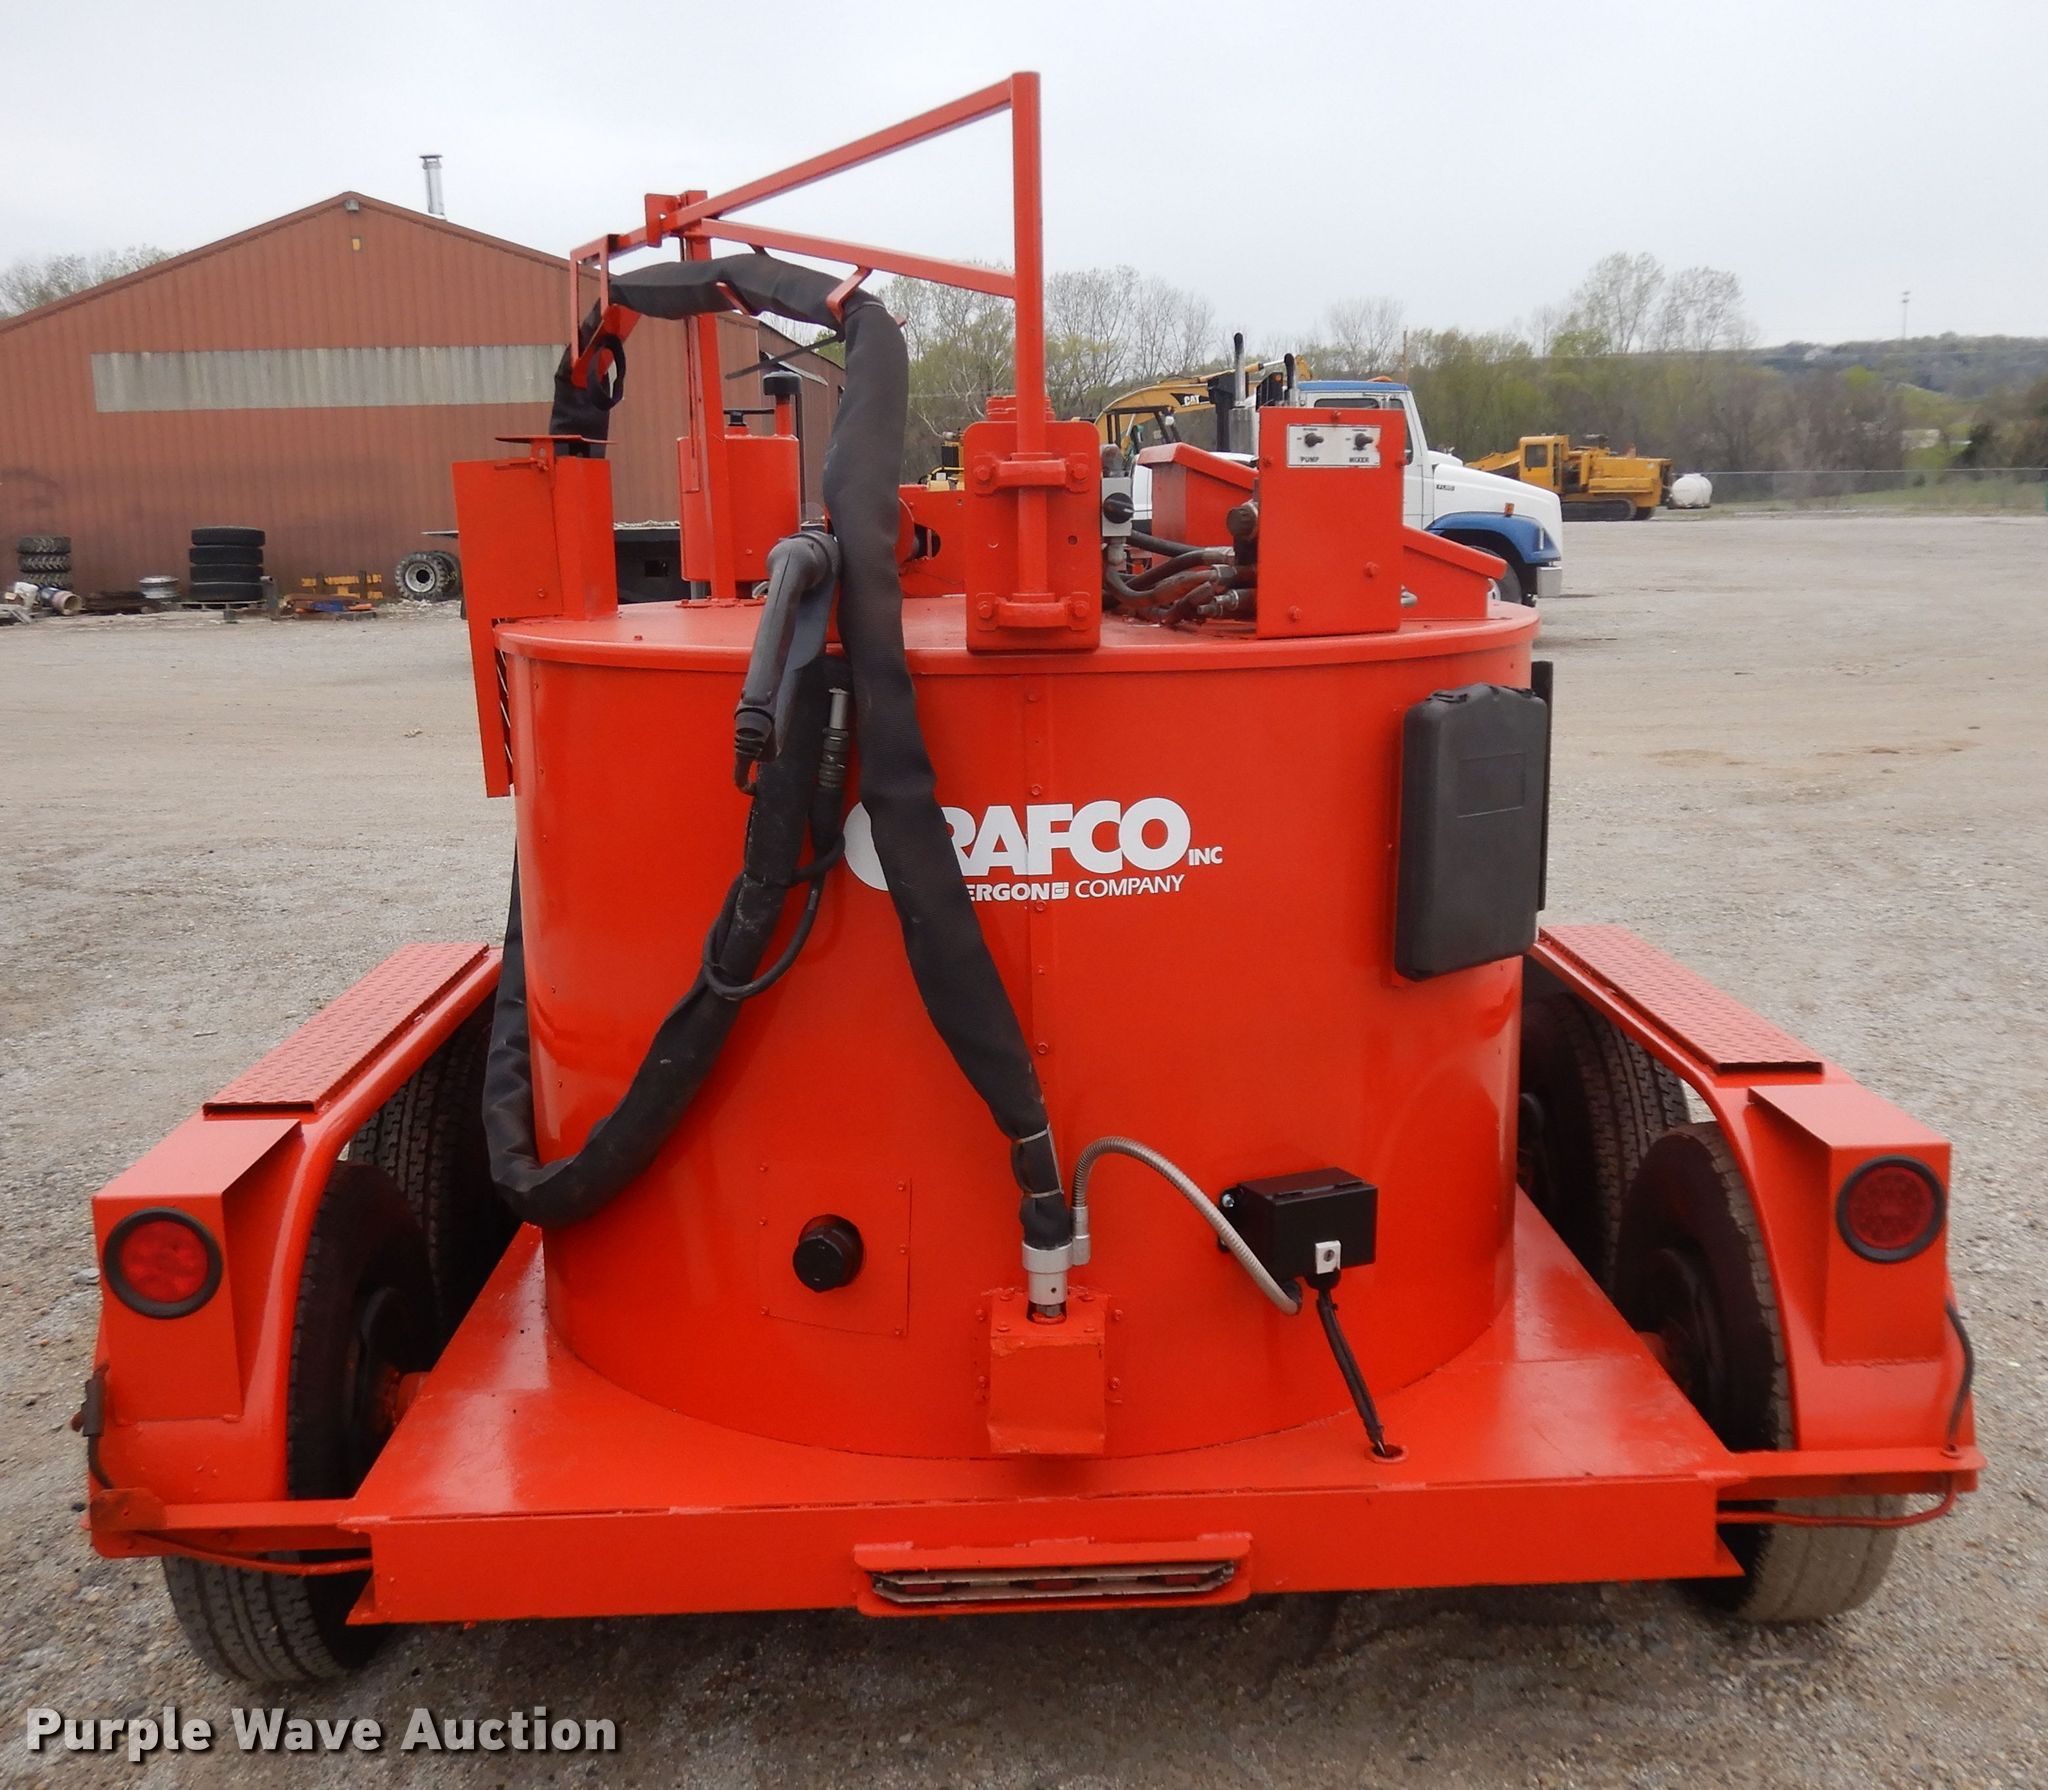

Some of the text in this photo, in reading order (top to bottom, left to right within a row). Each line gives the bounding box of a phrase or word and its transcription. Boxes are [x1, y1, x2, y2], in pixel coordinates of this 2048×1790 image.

[1184, 395, 1200, 406] CAT
[1188, 846, 1223, 866] INC
[1075, 874, 1185, 898] COMPANY
